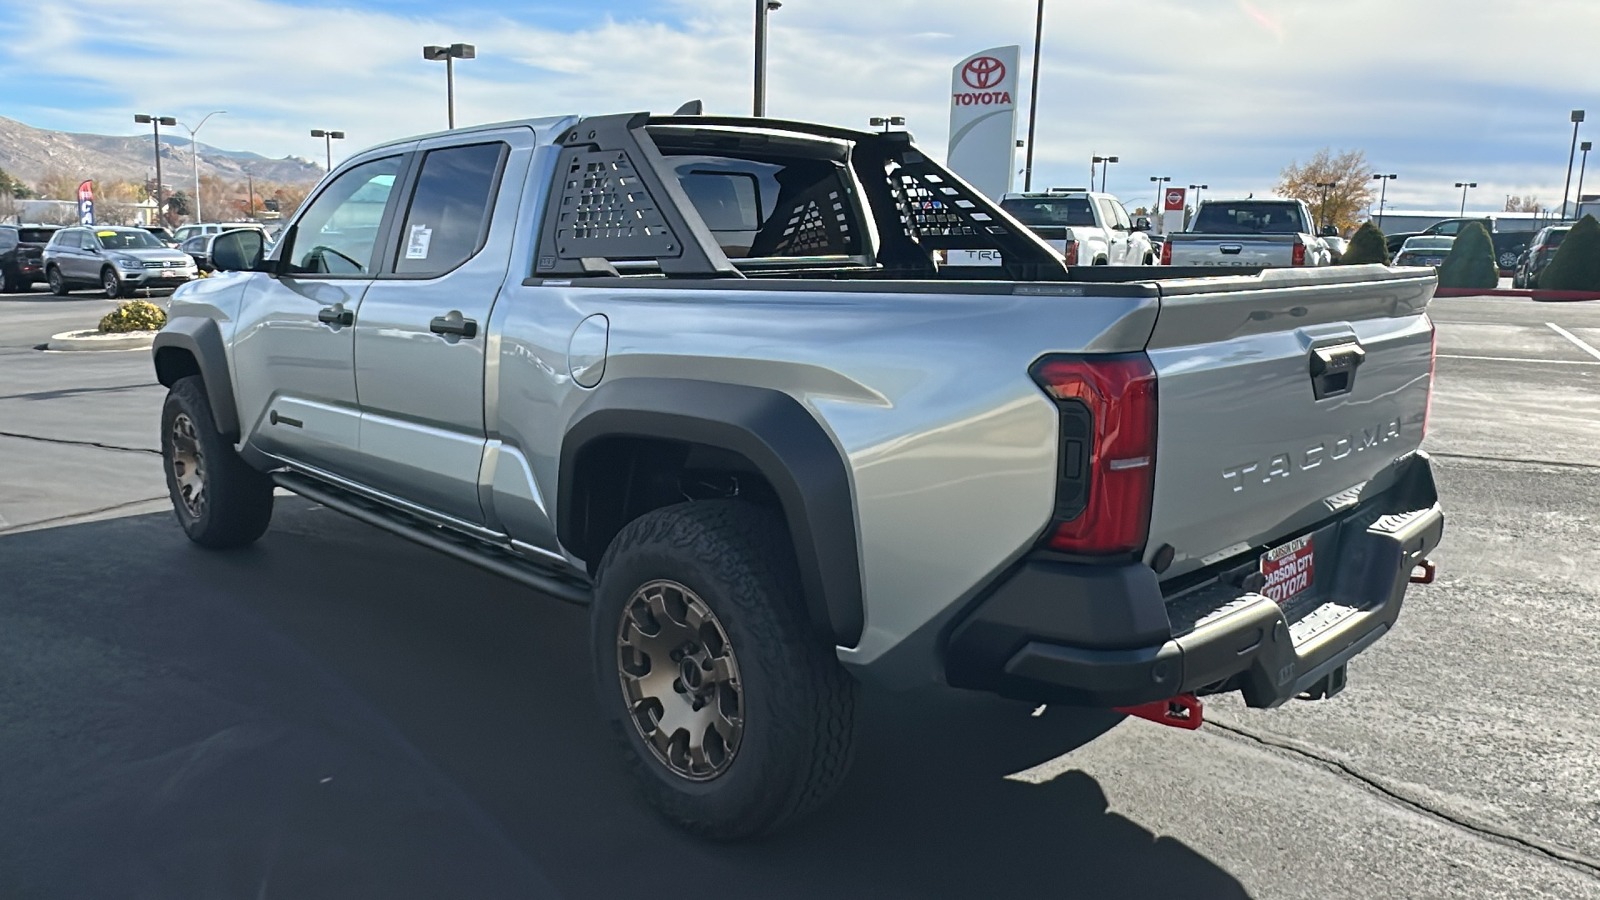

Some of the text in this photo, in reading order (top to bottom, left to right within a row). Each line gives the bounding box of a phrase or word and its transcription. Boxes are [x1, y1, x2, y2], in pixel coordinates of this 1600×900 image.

[953, 92, 1012, 106] TOYOTA
[1223, 417, 1400, 492] TACOMA
[1297, 552, 1313, 572] CITY
[1267, 571, 1307, 602] TOYOTA
